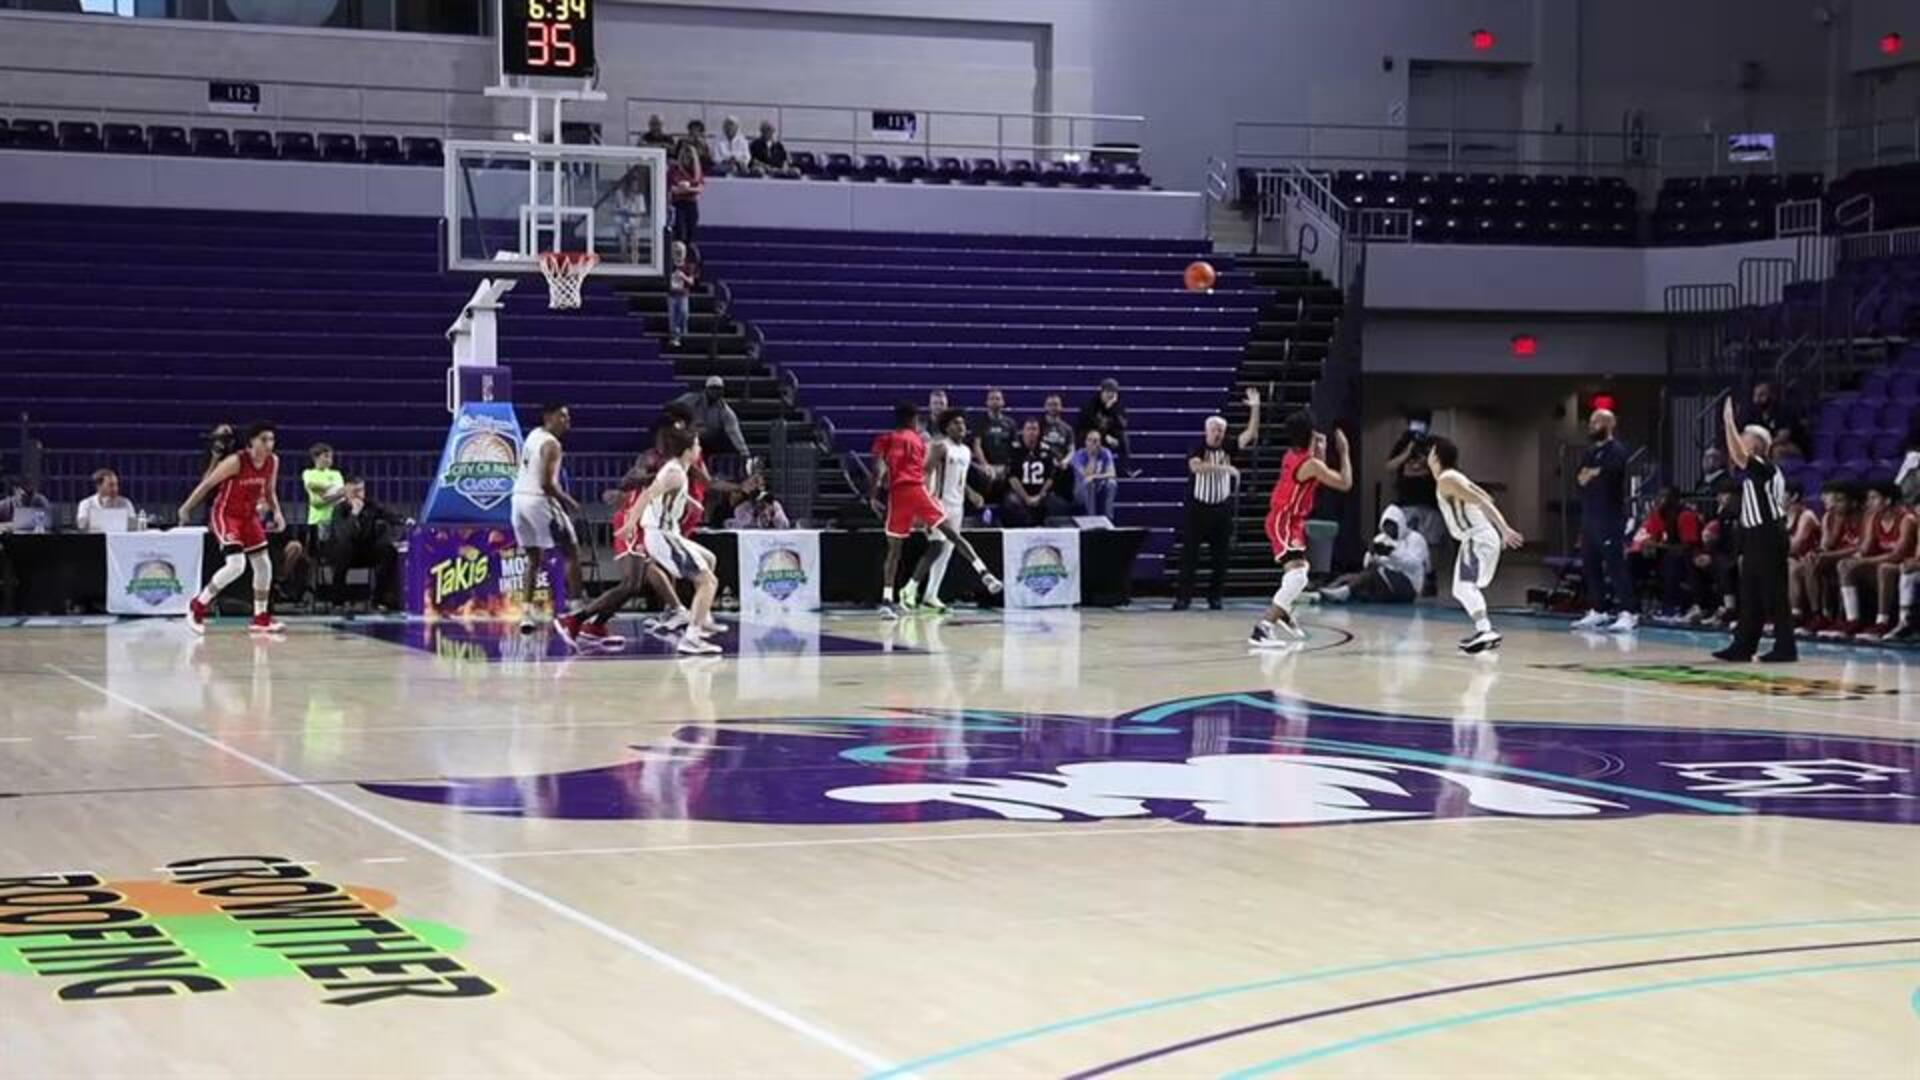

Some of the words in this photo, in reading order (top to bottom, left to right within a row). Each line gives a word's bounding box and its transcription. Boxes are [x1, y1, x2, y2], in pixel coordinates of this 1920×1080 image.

[529, 0, 586, 20] 6:34
[527, 22, 575, 67] 35
[228, 87, 251, 100] 112
[1022, 461, 1044, 484] 12
[430, 553, 488, 604] Takis
[0, 872, 229, 1001] ROOFING
[163, 855, 498, 1007] CROWTHER
